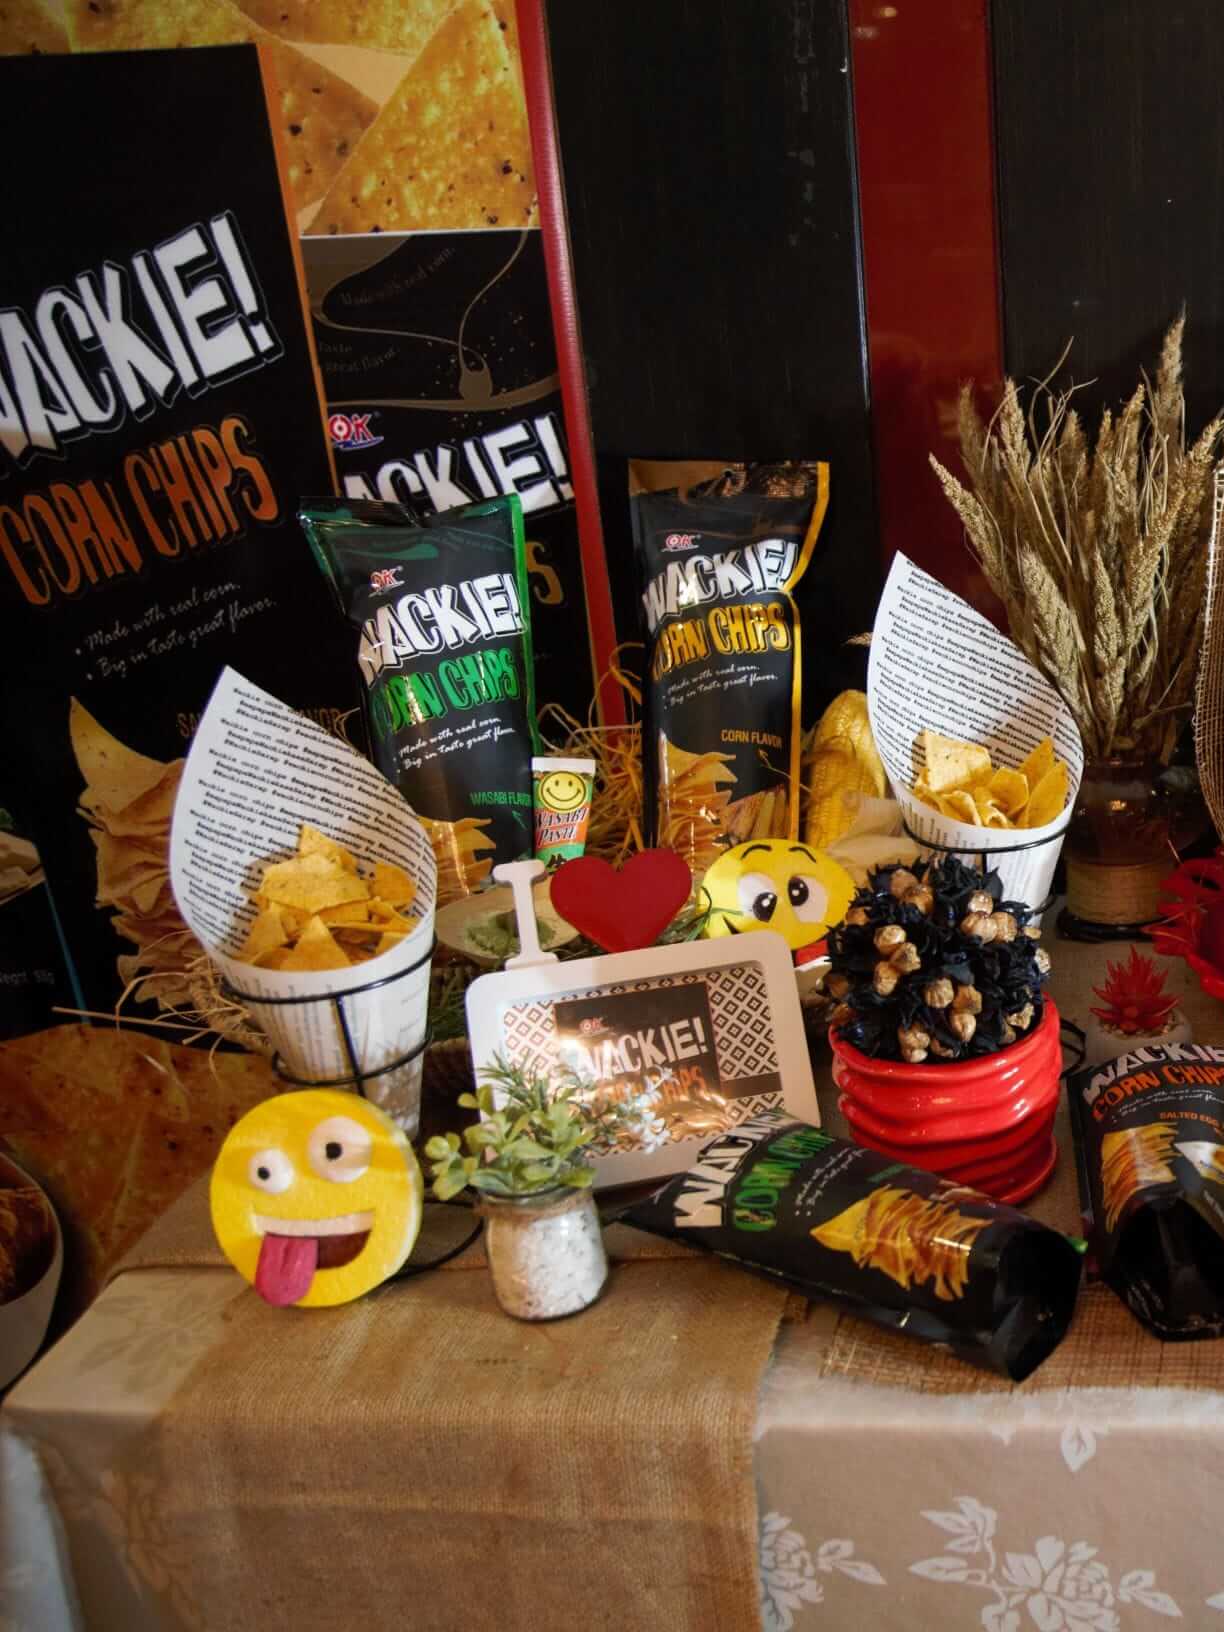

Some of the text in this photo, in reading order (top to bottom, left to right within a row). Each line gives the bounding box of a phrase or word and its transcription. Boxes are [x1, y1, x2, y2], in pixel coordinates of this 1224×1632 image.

[0, 417, 279, 606] CORN CHIPS
[642, 538, 799, 634] WACKIE!
[86, 619, 129, 650] Made
[132, 604, 166, 631] with
[169, 587, 199, 616] real
[358, 573, 527, 689] WACKIE!
[708, 602, 791, 655] CHIPS
[97, 656, 128, 679] Big
[131, 650, 148, 664] in
[148, 628, 185, 656] taste
[189, 608, 225, 648] great
[439, 647, 520, 710] CHIPS
[667, 679, 690, 695] Made
[691, 669, 713, 683] with
[715, 664, 735, 675] real
[697, 680, 721, 693] taste
[723, 675, 748, 691] great
[400, 738, 428, 757] Made
[429, 728, 453, 744] with
[456, 719, 477, 734] real
[404, 758, 422, 770] Big
[425, 751, 438, 760] in
[438, 740, 464, 753] taste
[467, 729, 492, 749] great
[720, 729, 782, 748] CORN FLAVOR
[469, 791, 508, 806] WASABI
[535, 808, 589, 831] WASABI
[1092, 1072, 1161, 1121] CORN
[1159, 1110, 1198, 1121] SALTED
